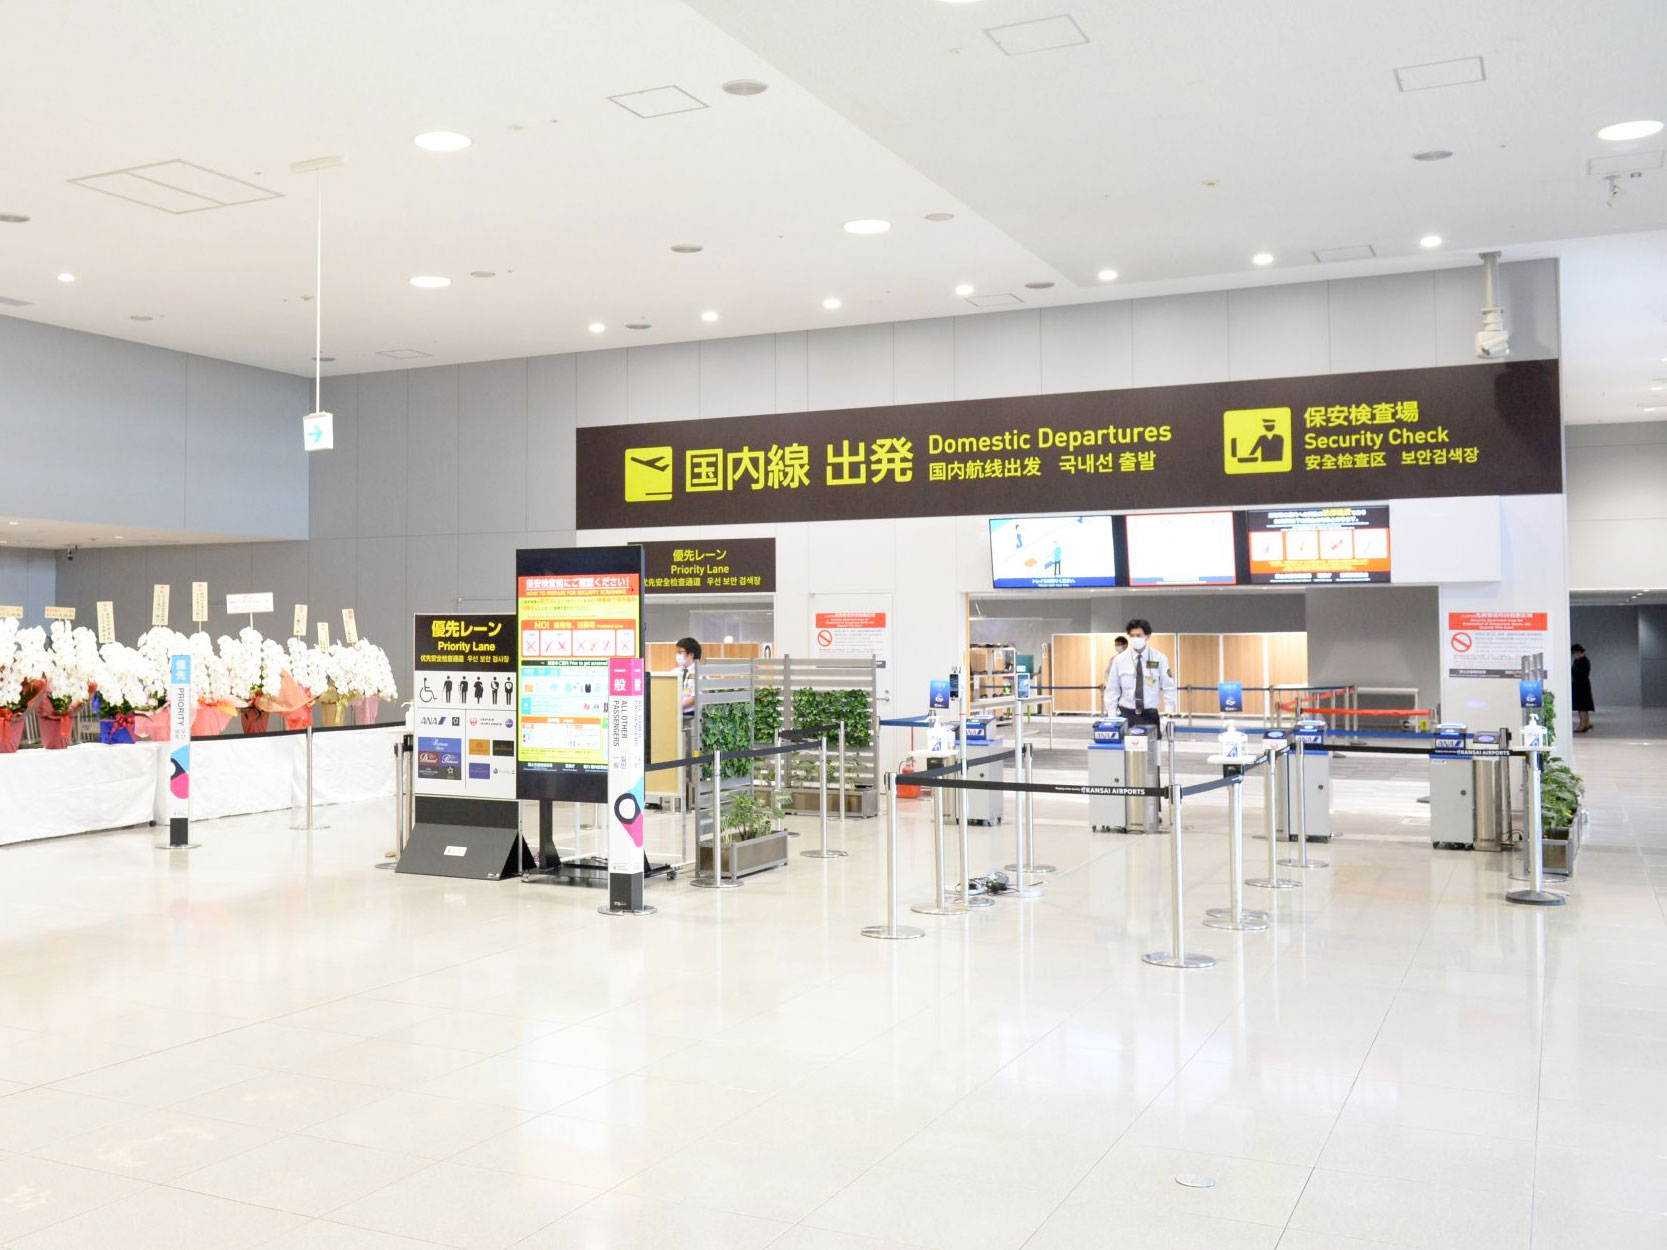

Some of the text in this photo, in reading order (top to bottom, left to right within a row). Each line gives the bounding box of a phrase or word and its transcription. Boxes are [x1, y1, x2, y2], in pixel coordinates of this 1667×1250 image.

[1303, 400, 1419, 428] 保安検査場
[928, 424, 1172, 455] Domestic Departures
[1304, 425, 1450, 450] Security Check
[685, 436, 914, 493] 国内線 出発
[1058, 450, 1157, 475] 국내선 출발
[1304, 451, 1387, 471] 安全检查区
[1401, 446, 1480, 465] 보안검색장
[929, 456, 1042, 481] 国内航线出发
[673, 549, 727, 562] 優先レーン
[670, 564, 730, 576] Priority Lane
[431, 620, 502, 638] 優先レーン
[437, 641, 496, 653] Priority Lane
[613, 668, 627, 692] 一般
[420, 716, 438, 725] ANA
[612, 700, 620, 747] PASSENGERS
[1111, 787, 1146, 795] AIRPORTS
